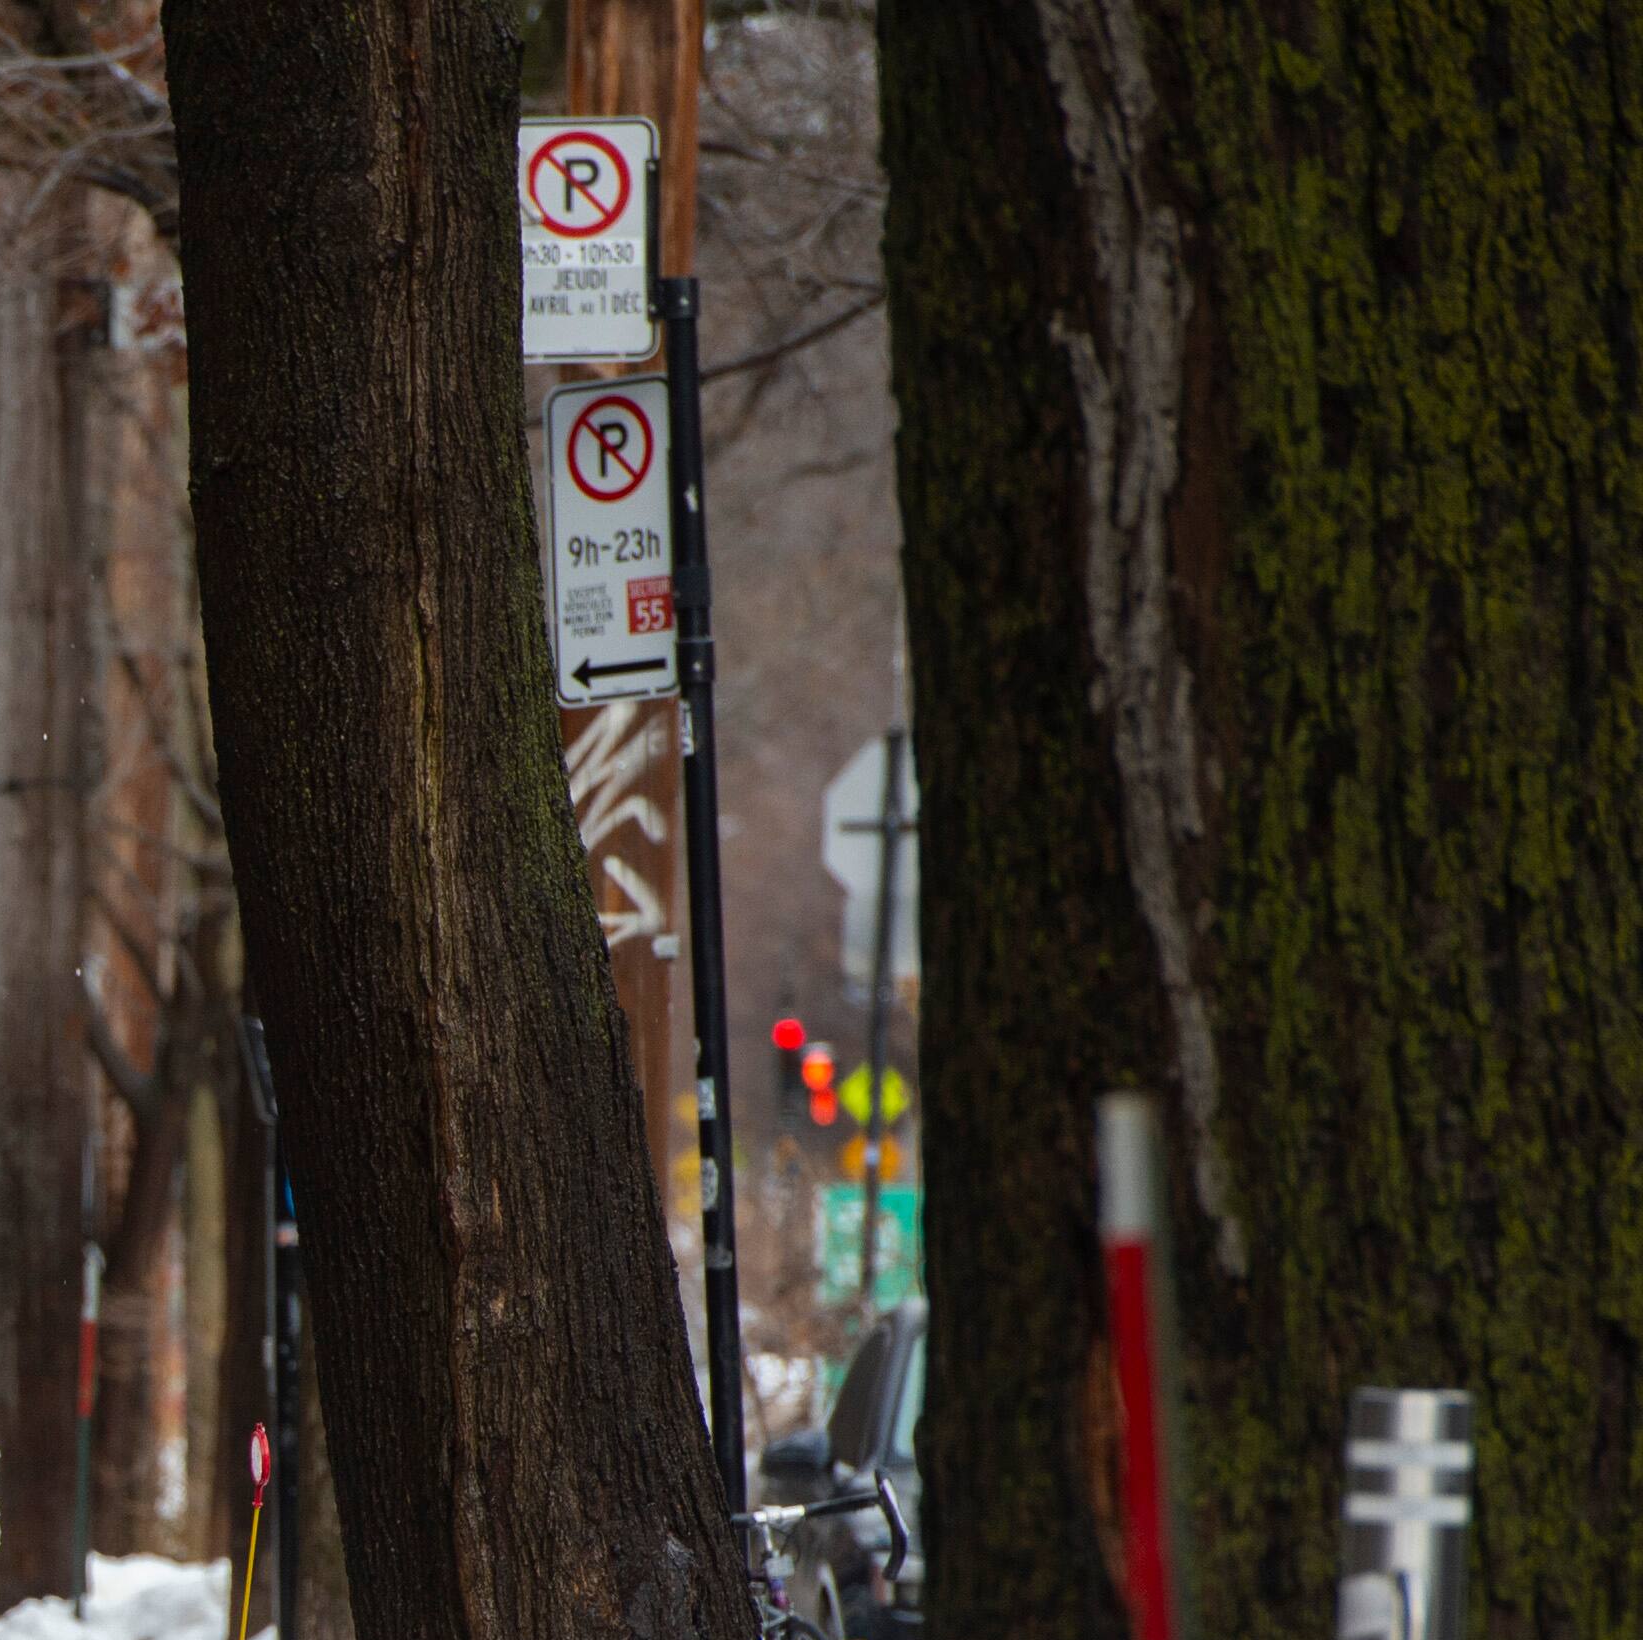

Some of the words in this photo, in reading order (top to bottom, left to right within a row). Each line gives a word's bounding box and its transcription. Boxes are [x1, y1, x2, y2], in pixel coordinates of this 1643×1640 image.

[523, 242, 561, 266] h30
[580, 241, 634, 265] 10h30
[553, 269, 608, 290] JEUDI
[530, 294, 573, 315] AVRIL
[568, 527, 661, 568] 9h-23h
[635, 599, 665, 632] 55
